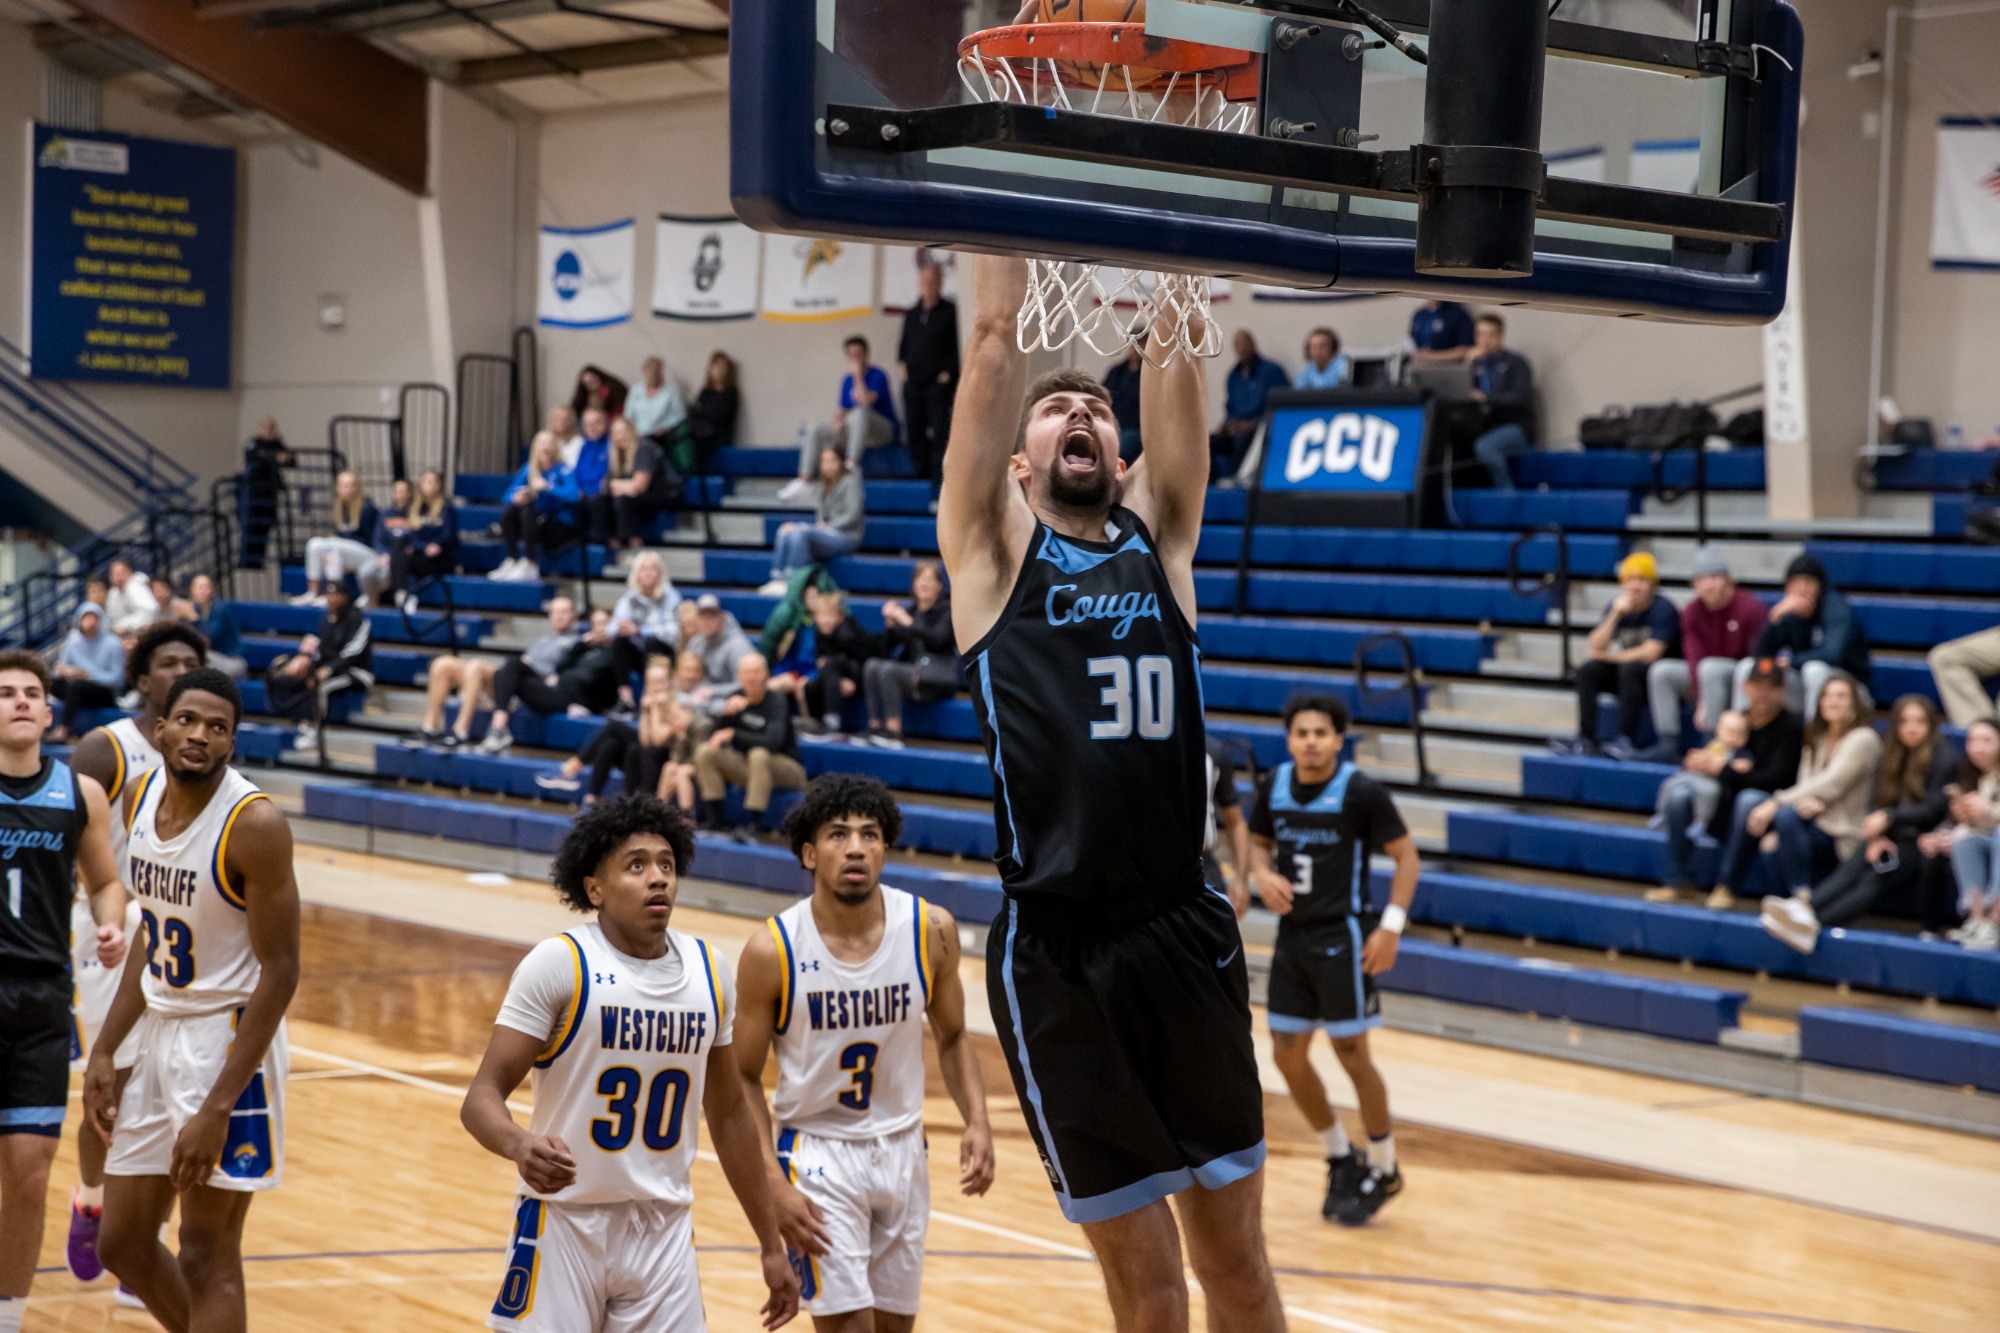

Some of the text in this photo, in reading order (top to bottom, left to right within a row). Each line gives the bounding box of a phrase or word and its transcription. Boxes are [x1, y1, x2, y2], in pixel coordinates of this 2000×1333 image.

[1285, 412, 1399, 483] CCU
[1045, 584, 1162, 640] Couga
[1087, 655, 1175, 740] 30
[0, 829, 64, 860] ugars
[6, 867, 22, 919] 1
[1292, 853, 1313, 894] 3
[141, 906, 197, 989] 23
[600, 1005, 706, 1054] WESTCLIFF
[807, 983, 912, 1031] WESTCLIFF
[837, 1041, 879, 1111] 3
[590, 1064, 691, 1153] 30
